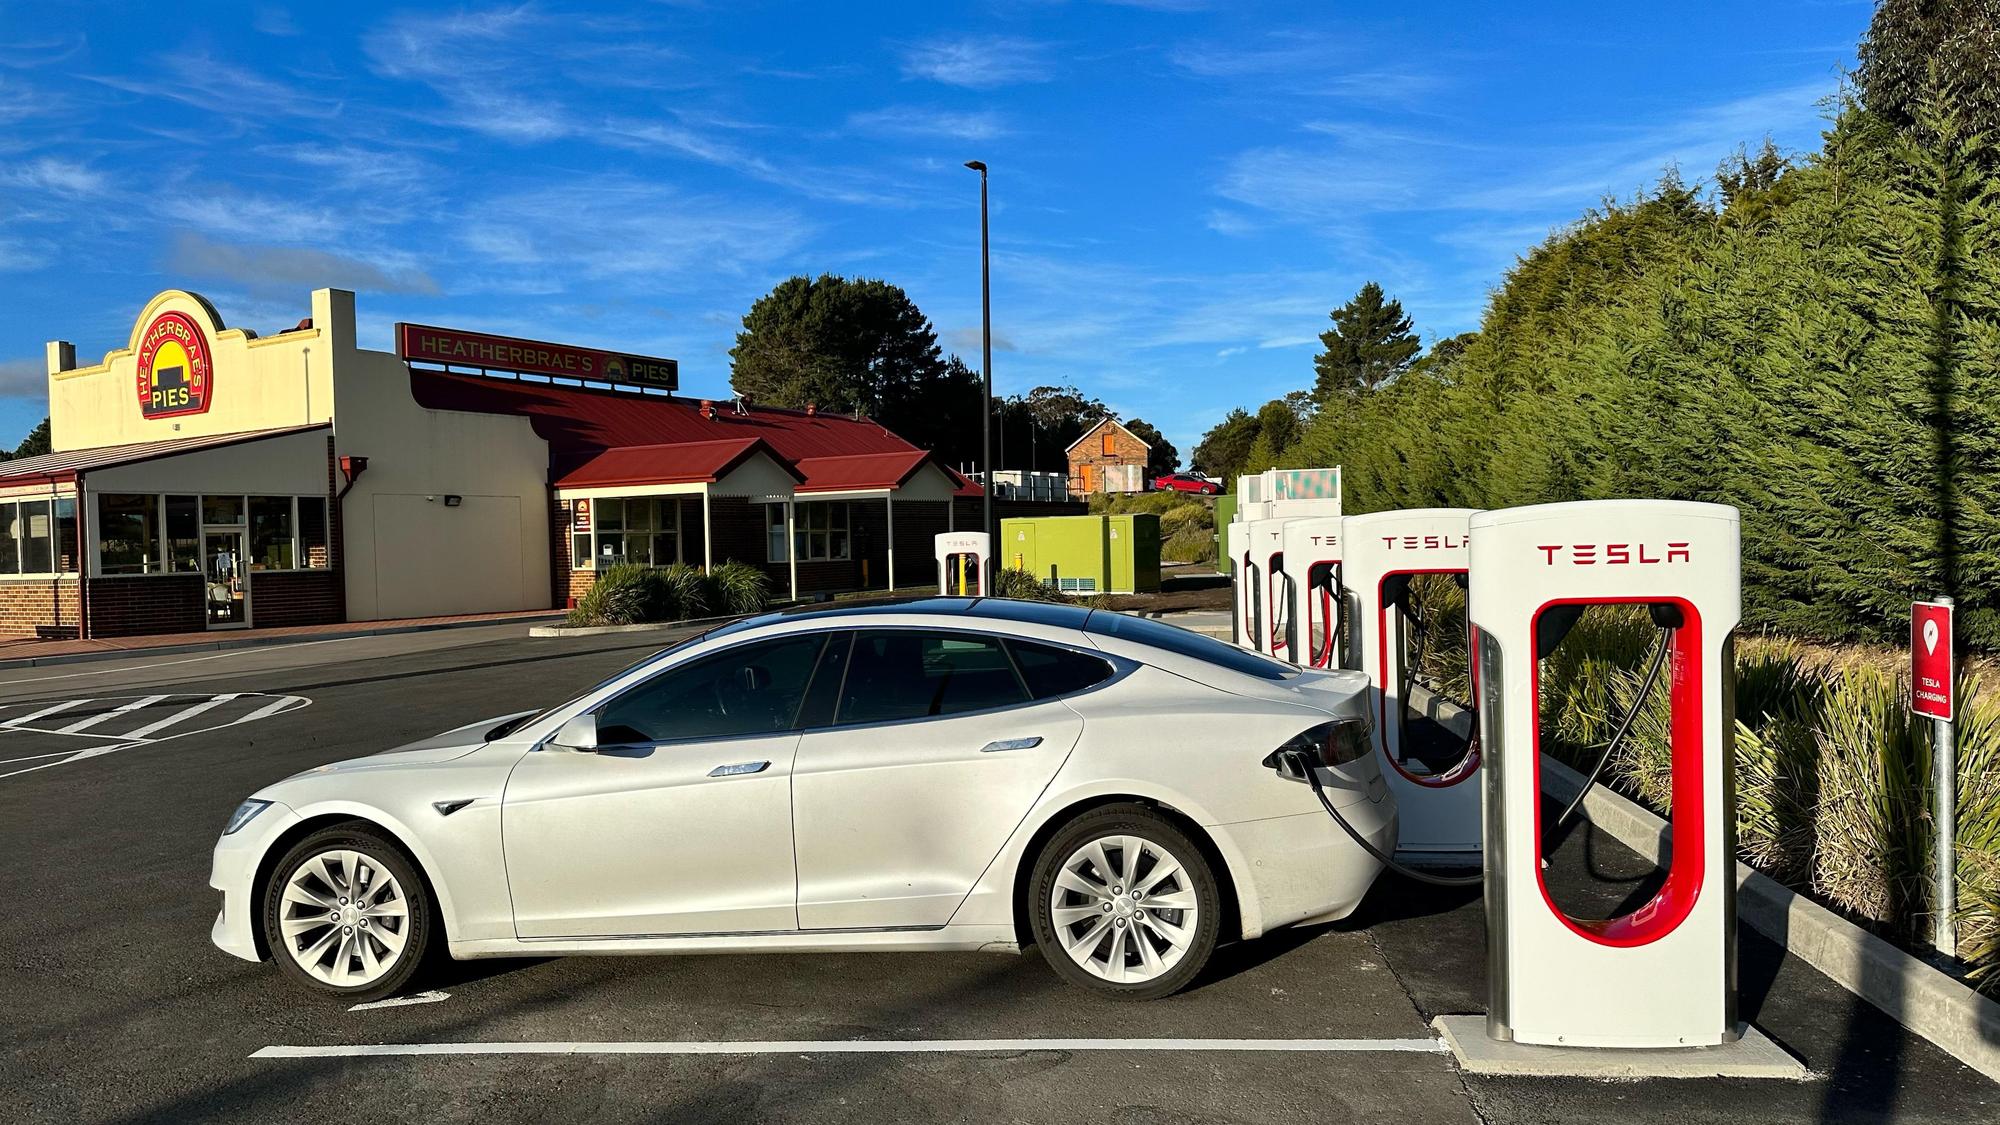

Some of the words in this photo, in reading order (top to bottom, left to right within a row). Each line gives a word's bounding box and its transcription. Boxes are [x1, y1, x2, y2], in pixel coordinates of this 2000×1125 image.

[139, 321, 202, 395] HEATHERBRAE'S
[420, 334, 593, 372] HEATHERBRAE'S
[632, 362, 670, 382] PIES
[152, 387, 190, 409] PIES
[1537, 543, 1690, 565] TESLA
[1922, 677, 1940, 688] TESLA
[1916, 691, 1947, 704] CHARGING
